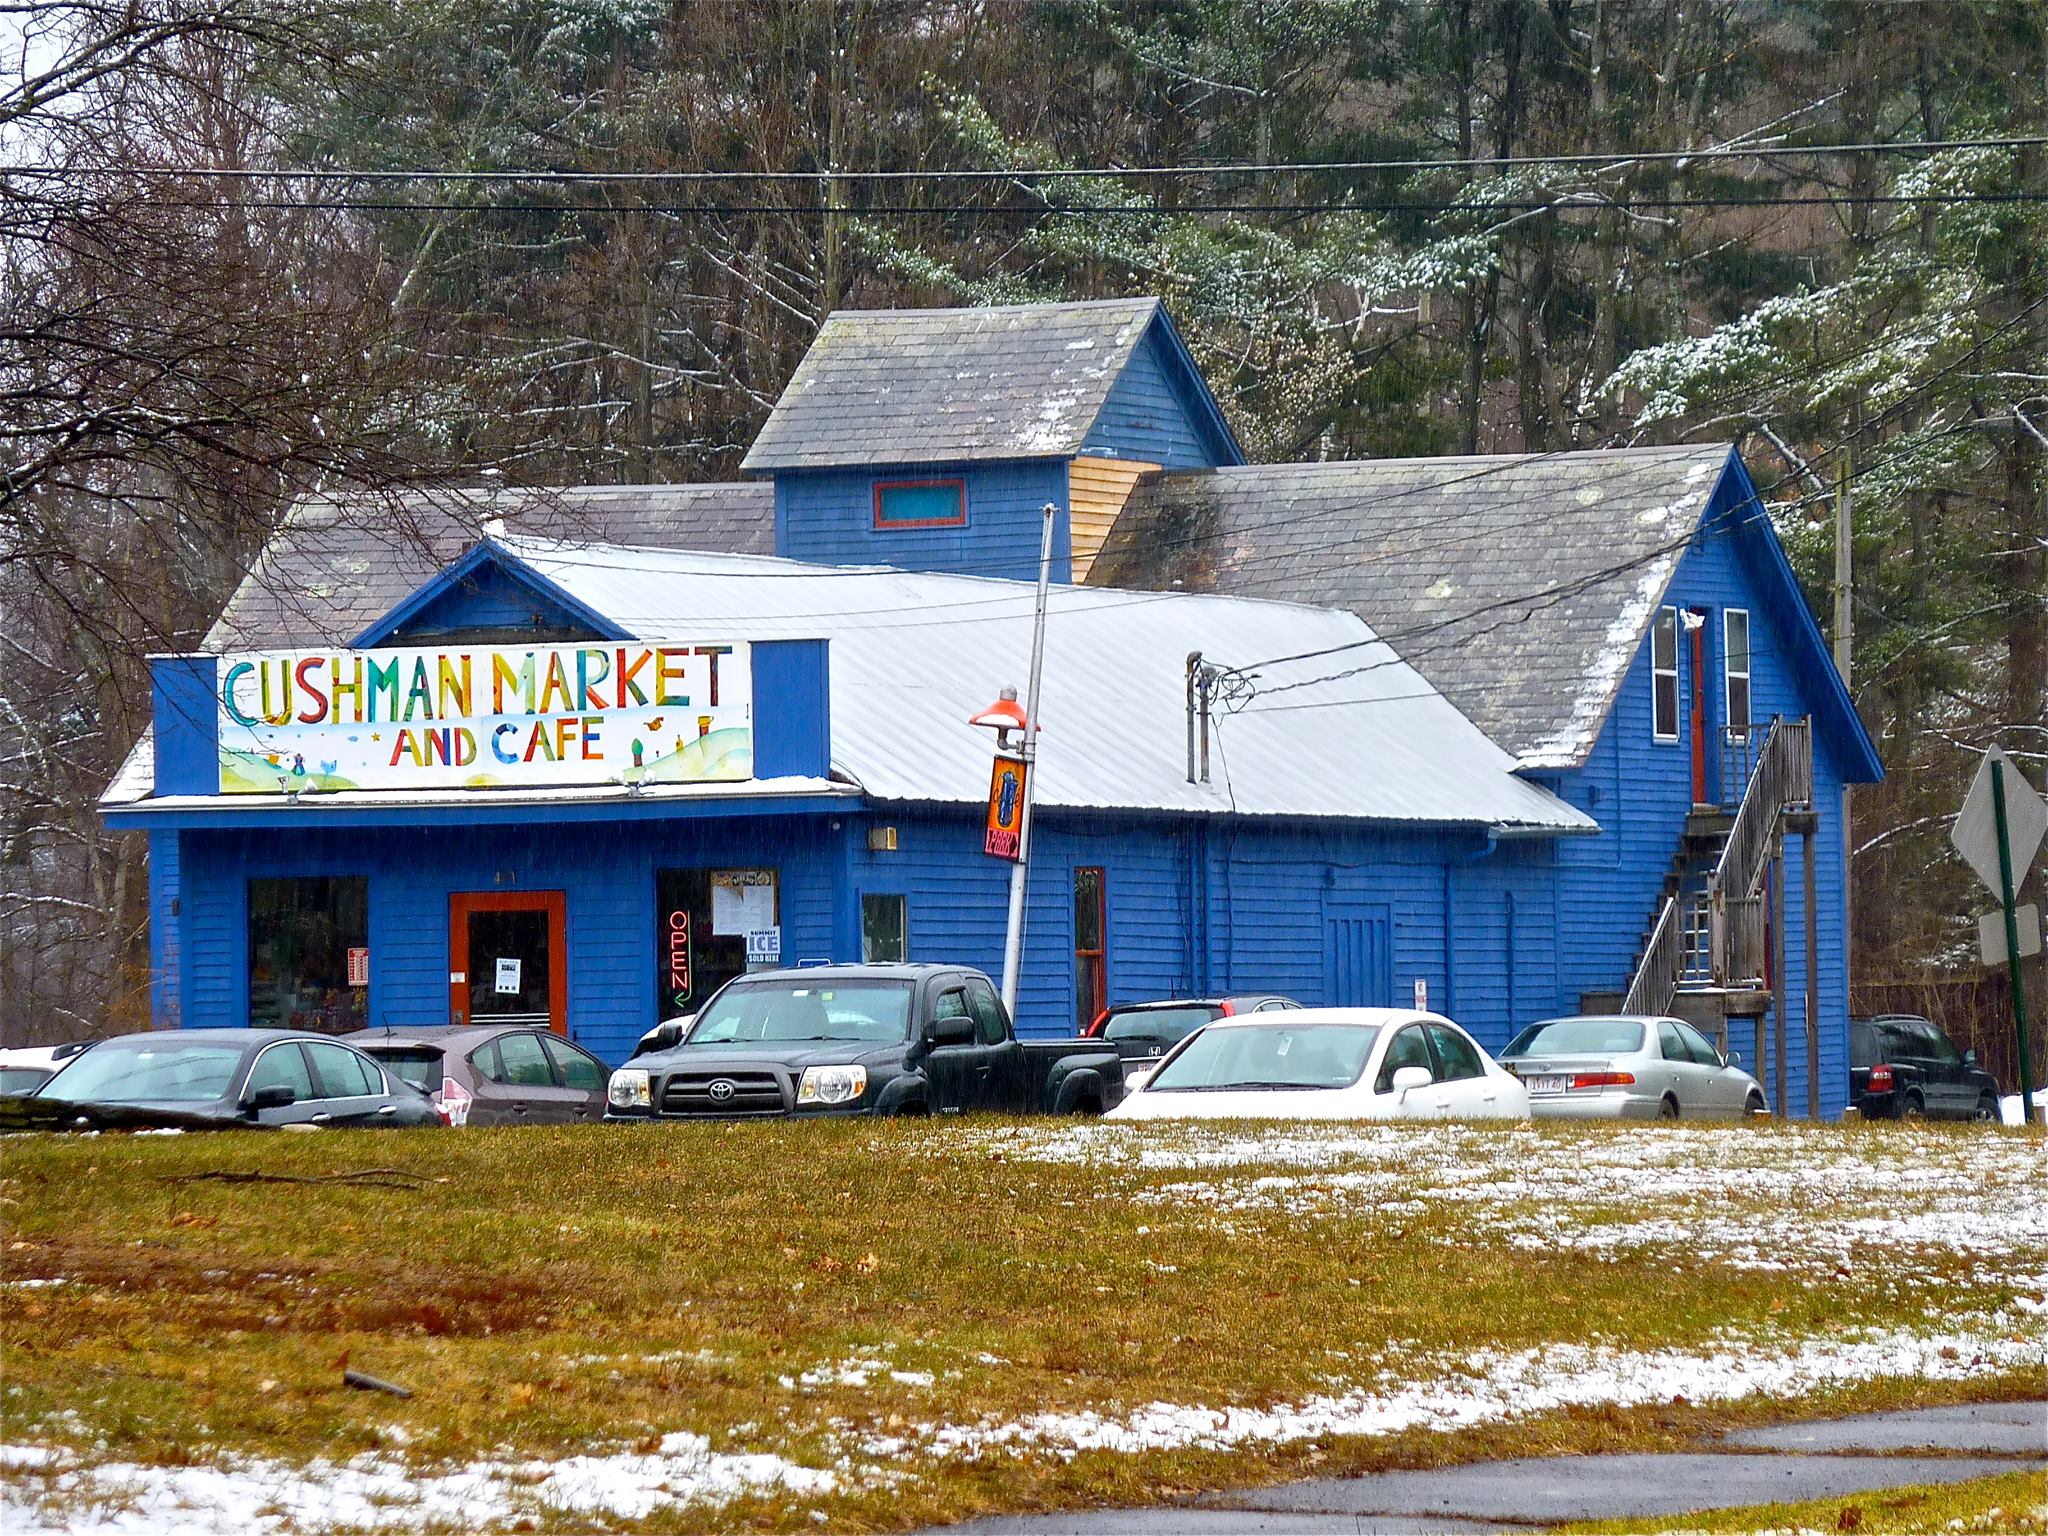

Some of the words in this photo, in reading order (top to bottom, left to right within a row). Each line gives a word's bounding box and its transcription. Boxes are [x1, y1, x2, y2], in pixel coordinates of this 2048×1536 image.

[223, 655, 473, 726] CUSHMAN
[493, 646, 733, 715] MARKET
[389, 727, 478, 767] AND
[491, 716, 604, 765] CAFE
[669, 910, 688, 990] OPEN
[748, 954, 764, 962] SOLD
[765, 954, 780, 962] HERE
[749, 936, 779, 952] ICE
